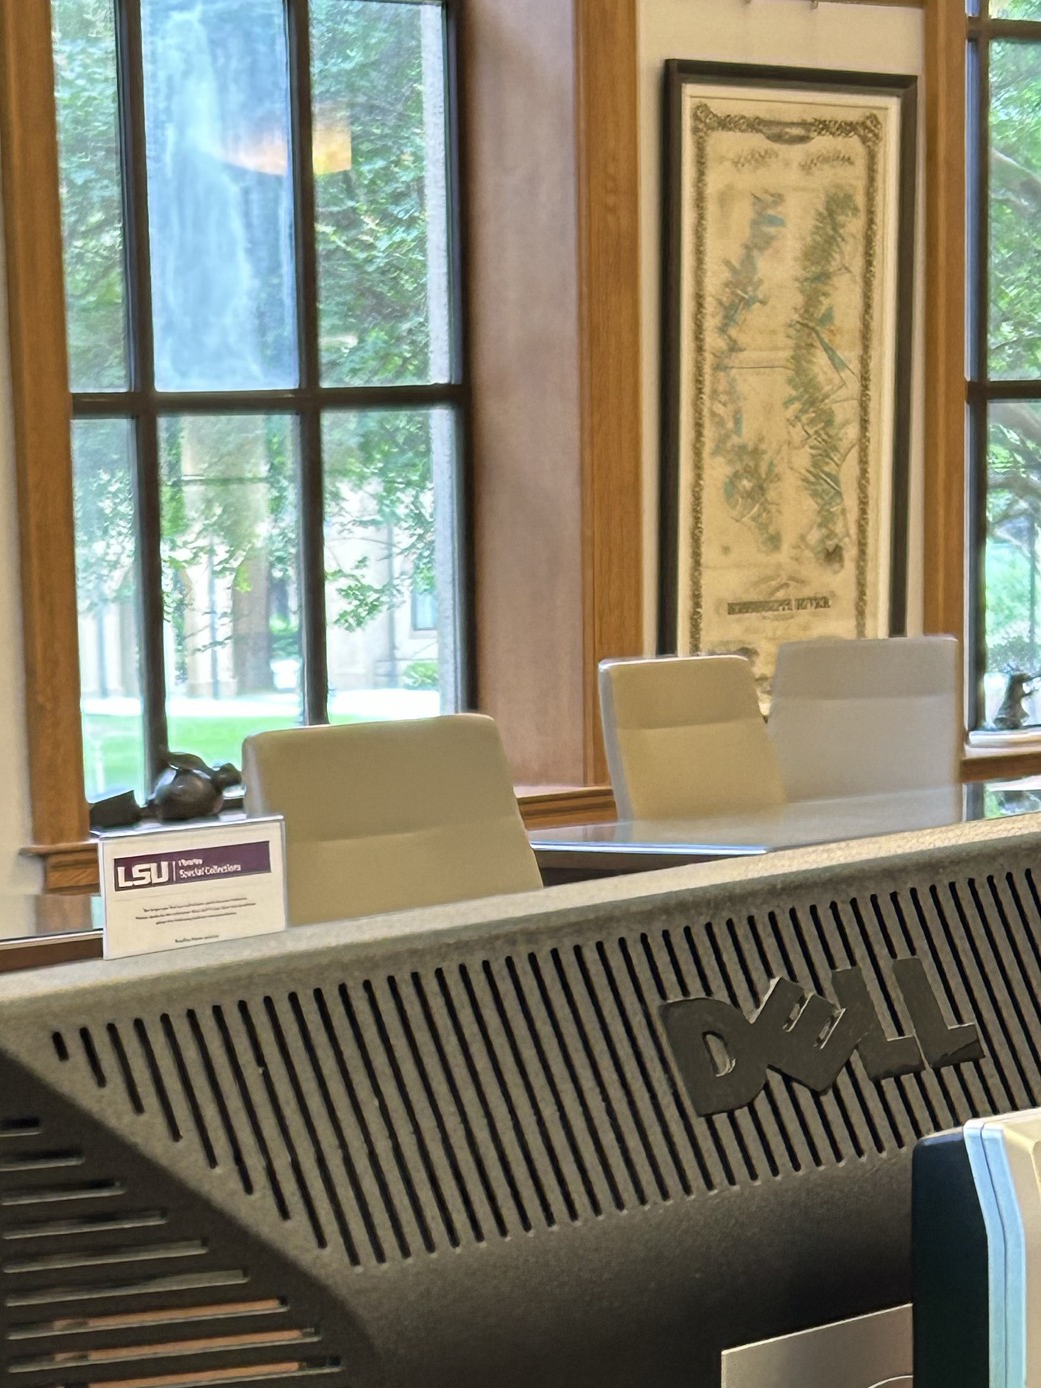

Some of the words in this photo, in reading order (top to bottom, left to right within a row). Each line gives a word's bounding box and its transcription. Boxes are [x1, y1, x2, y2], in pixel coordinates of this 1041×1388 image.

[117, 861, 169, 888] LSU
[205, 864, 242, 876] Collections
[658, 956, 985, 1118] DELL
